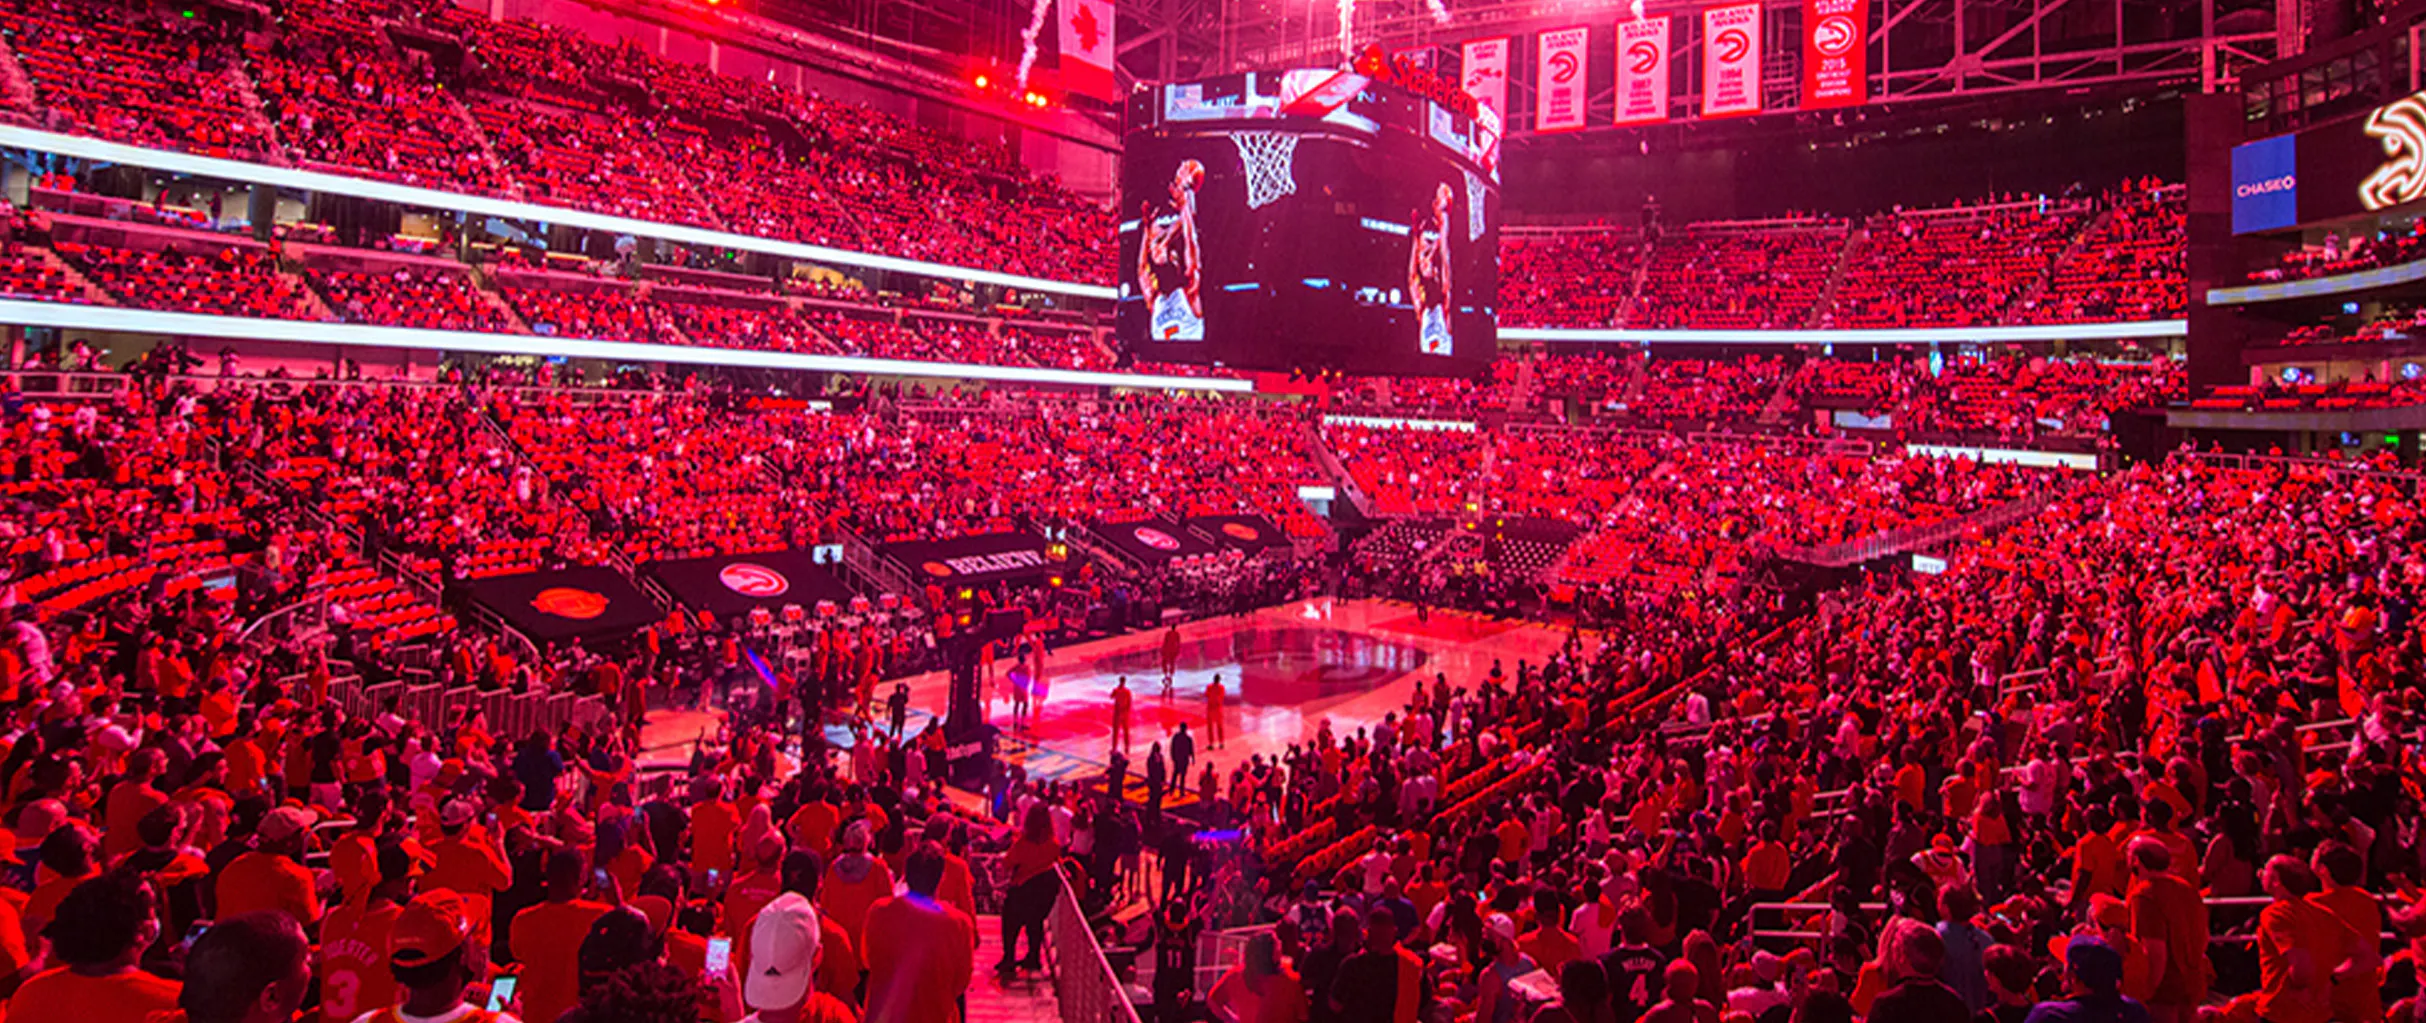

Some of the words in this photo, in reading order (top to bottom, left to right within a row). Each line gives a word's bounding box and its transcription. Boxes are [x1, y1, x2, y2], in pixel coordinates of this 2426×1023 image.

[2237, 180, 2283, 198] CHASE
[323, 969, 361, 1017] 3
[1628, 973, 1649, 1007] 4
